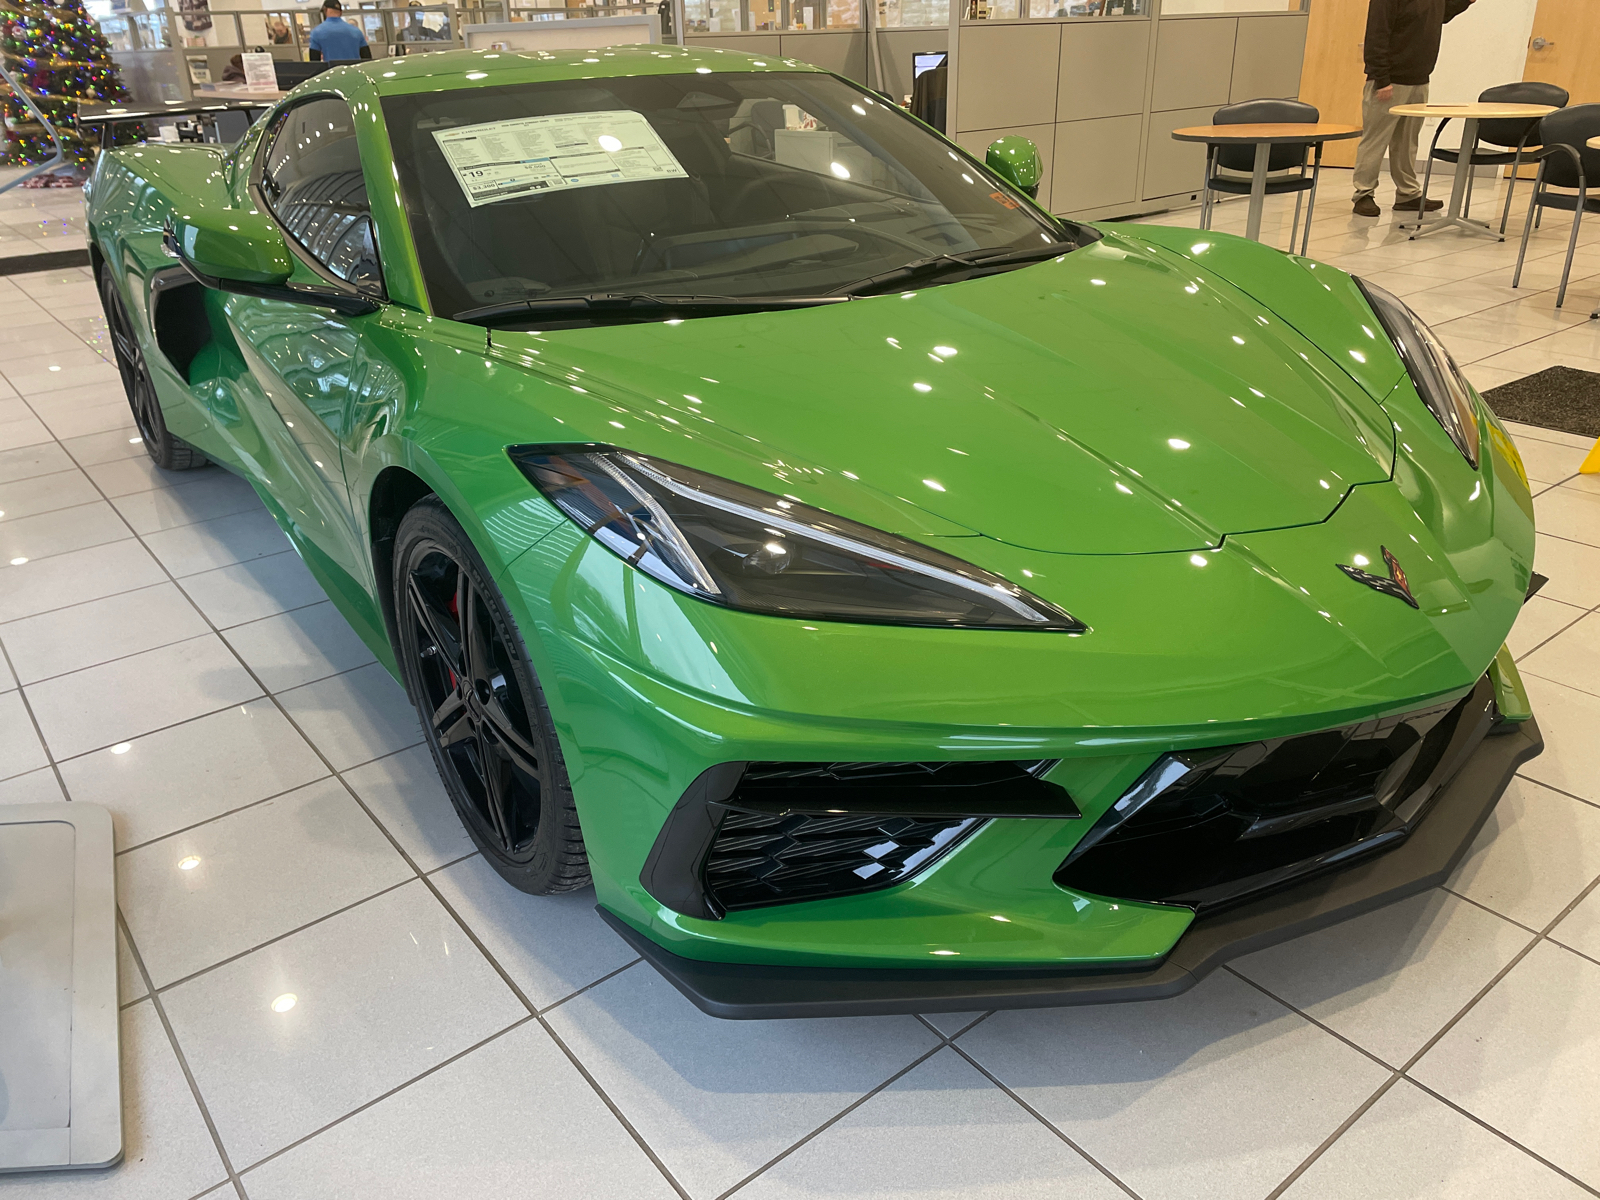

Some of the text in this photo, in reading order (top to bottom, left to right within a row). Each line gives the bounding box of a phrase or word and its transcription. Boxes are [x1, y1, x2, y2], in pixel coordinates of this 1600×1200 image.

[461, 127, 496, 135] CHEVROLET
[468, 170, 484, 178] 19
[472, 569, 516, 655] MICHELIN
